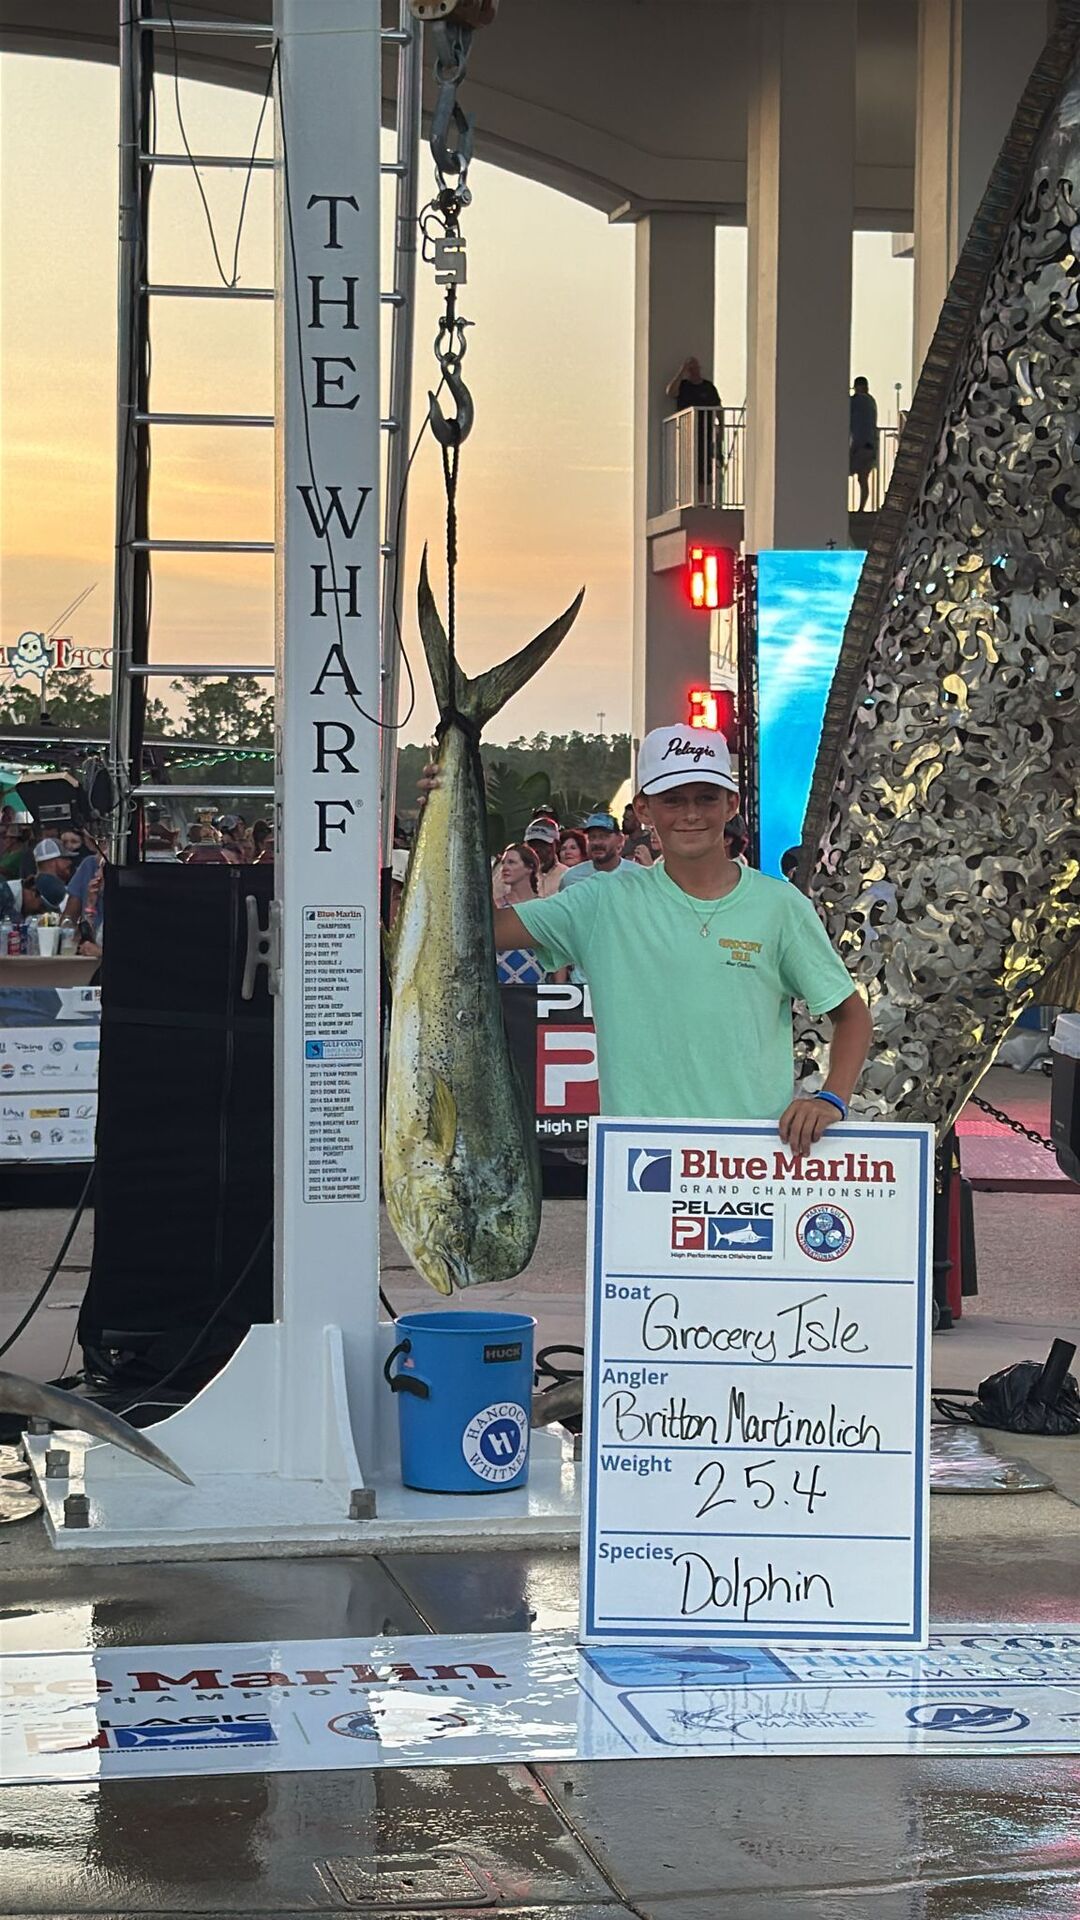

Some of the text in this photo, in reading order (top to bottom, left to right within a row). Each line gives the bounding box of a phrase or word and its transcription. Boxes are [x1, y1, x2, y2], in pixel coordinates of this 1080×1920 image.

[306, 194, 360, 411] THE
[296, 485, 373, 852] WHARF
[661, 737, 716, 763] Pelagic
[536, 1119, 572, 1135] High
[680, 1148, 896, 1183] Blue Marlin
[680, 1184, 898, 1198] GRAND CHAMPIONSHIP
[672, 1200, 774, 1216] PELAGIC
[605, 1284, 650, 1300] Boat
[642, 1292, 869, 1362] Grocery Isle
[486, 1347, 521, 1360] HUCK
[602, 1368, 668, 1389] Angler
[466, 1405, 527, 1440] HANCOCK
[602, 1386, 880, 1452] Britton Martinolich
[469, 1446, 526, 1480] WHITNEY
[600, 1455, 672, 1476] Weight
[694, 1460, 827, 1518] 25.4
[598, 1544, 674, 1564] Species
[673, 1552, 834, 1622] Dolphin
[127, 1663, 507, 1692] Marlin
